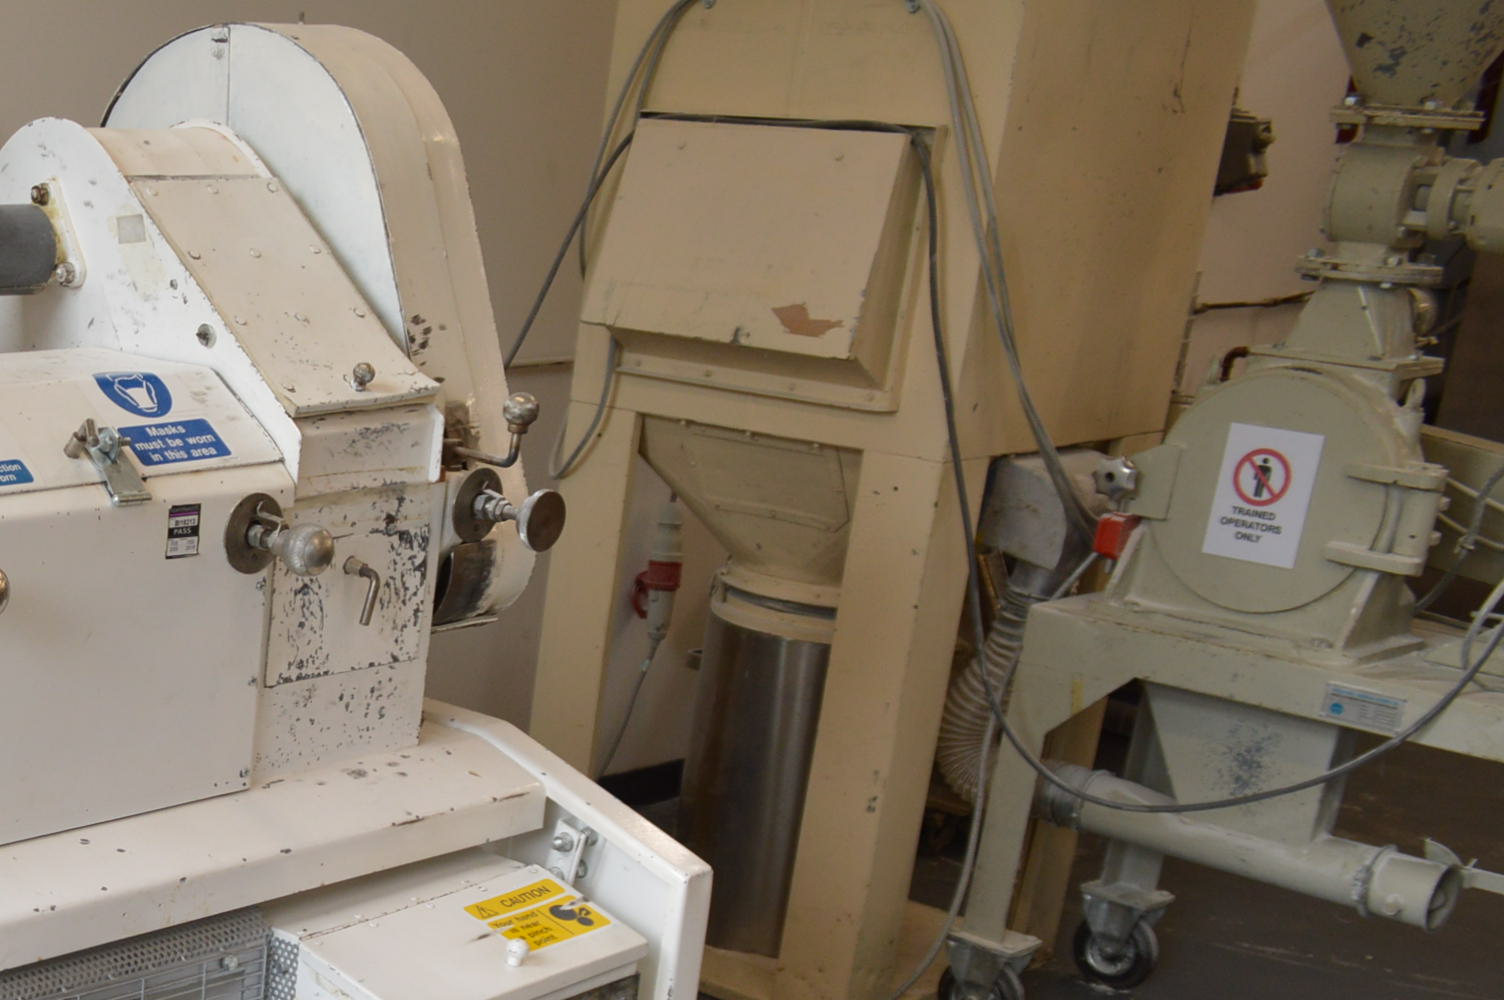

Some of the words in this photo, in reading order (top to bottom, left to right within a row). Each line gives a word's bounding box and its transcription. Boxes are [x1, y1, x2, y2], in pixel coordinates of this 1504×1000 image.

[145, 424, 186, 437] Masks
[134, 439, 166, 451] must
[166, 437, 184, 447] be
[185, 434, 216, 445] worn
[149, 451, 164, 462] in
[163, 448, 188, 459] this
[190, 446, 218, 457] area
[1231, 505, 1276, 521] TRAINED
[173, 527, 192, 536] PASS
[1220, 516, 1282, 535] OPERATORS
[1234, 531, 1263, 543] ONLY
[500, 886, 552, 907] CAUTION
